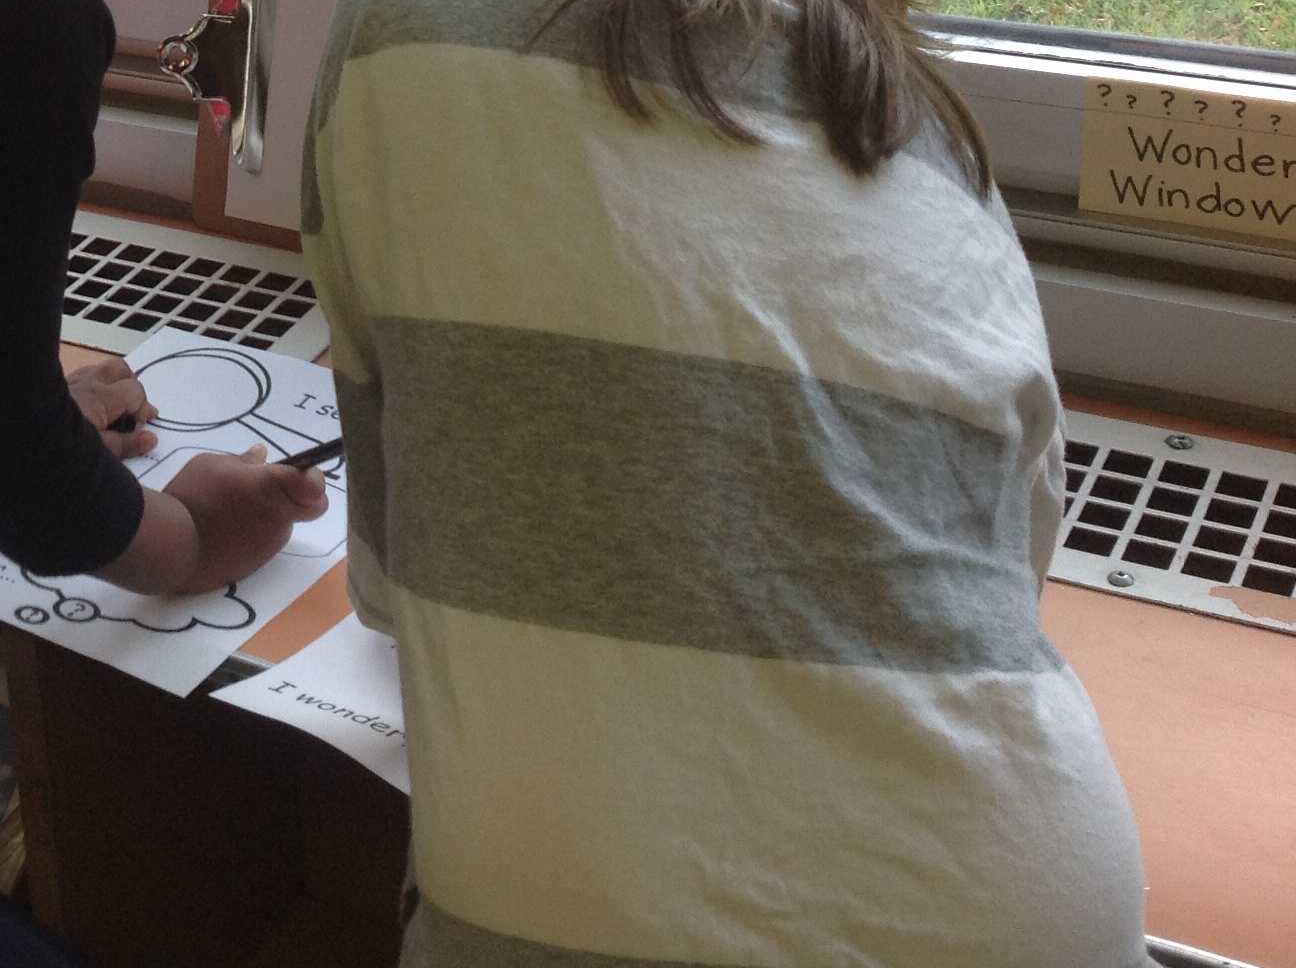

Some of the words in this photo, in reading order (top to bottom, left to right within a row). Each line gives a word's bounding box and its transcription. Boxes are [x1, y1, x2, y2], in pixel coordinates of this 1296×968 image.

[1128, 126, 1296, 179] Wonder
[1110, 169, 1296, 226] Window
[293, 393, 317, 410] I
[267, 680, 297, 694] I
